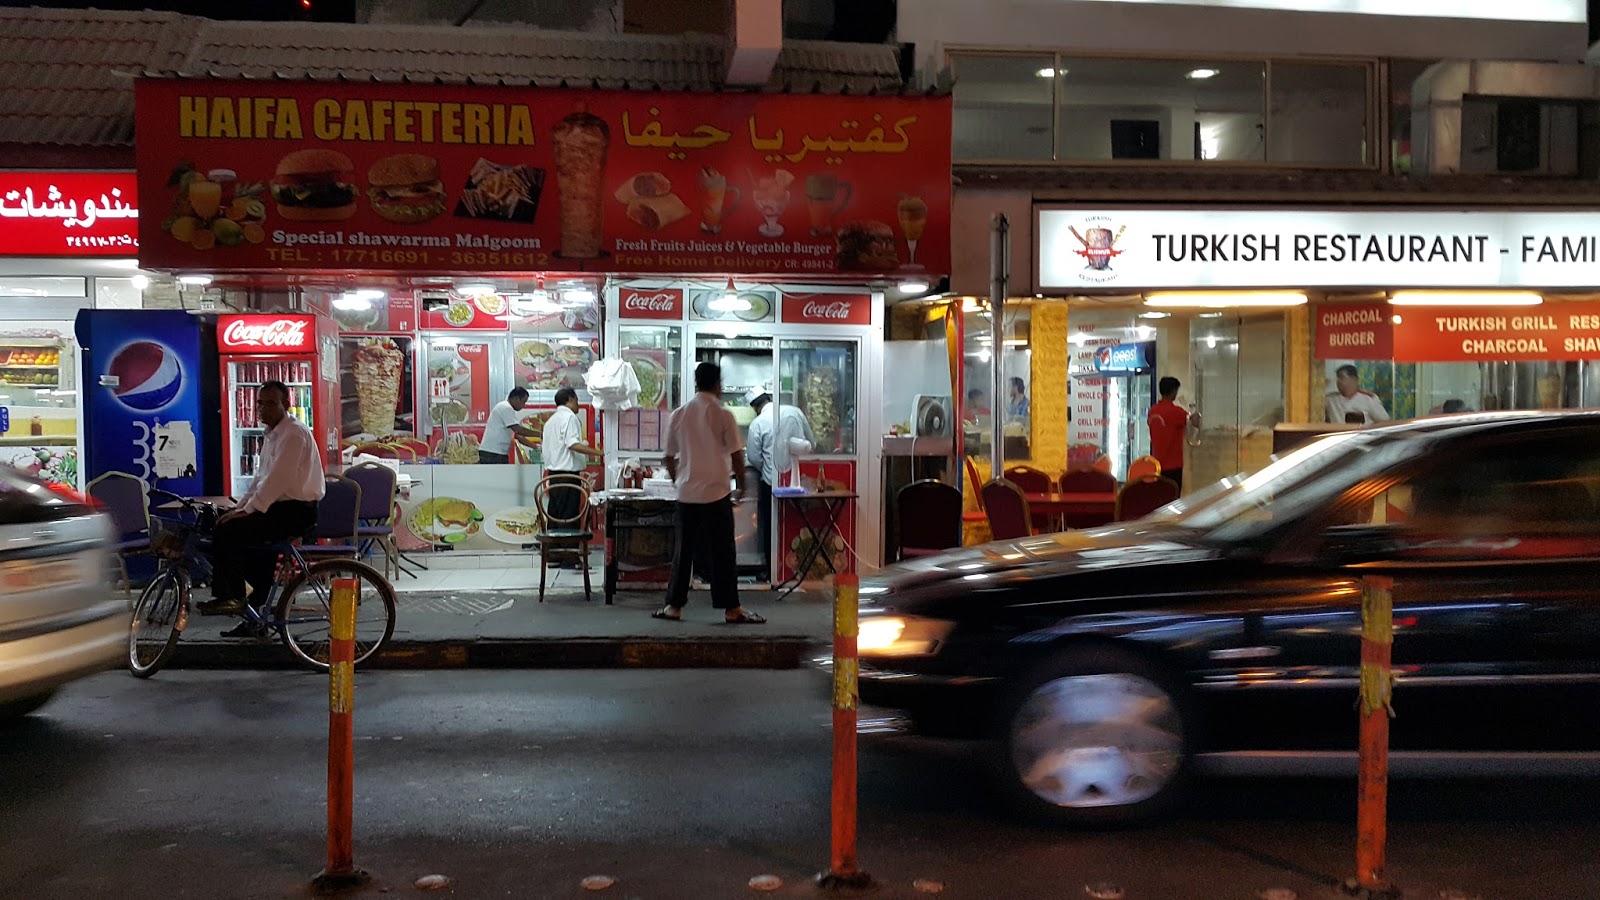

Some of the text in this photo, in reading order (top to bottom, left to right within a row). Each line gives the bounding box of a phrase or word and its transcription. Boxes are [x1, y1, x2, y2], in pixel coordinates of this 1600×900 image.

[178, 95, 535, 147] HAIFA CAFETERIA
[621, 105, 918, 165] كفتيريا حيفا
[271, 230, 542, 251] Special shawarma Malgoom
[615, 239, 832, 257] Fresh Fruits Juices & Vegetable Burger
[1152, 234, 1280, 262] TURKISH
[1294, 234, 1488, 263] RESTAURANT
[1522, 235, 1597, 263] FAMI
[266, 248, 309, 261] TEL
[331, 250, 430, 264] 17716691
[452, 251, 549, 266] 36351612
[615, 255, 654, 267] Free
[659, 256, 708, 268] Home
[713, 256, 782, 270] Delivery
[1322, 309, 1383, 326] CHARCOAL
[1436, 317, 1507, 332] TURKISH
[1511, 316, 1558, 331] GRILL
[1329, 332, 1375, 346] BURGER
[1462, 337, 1600, 354] CHARCOAL SHA
